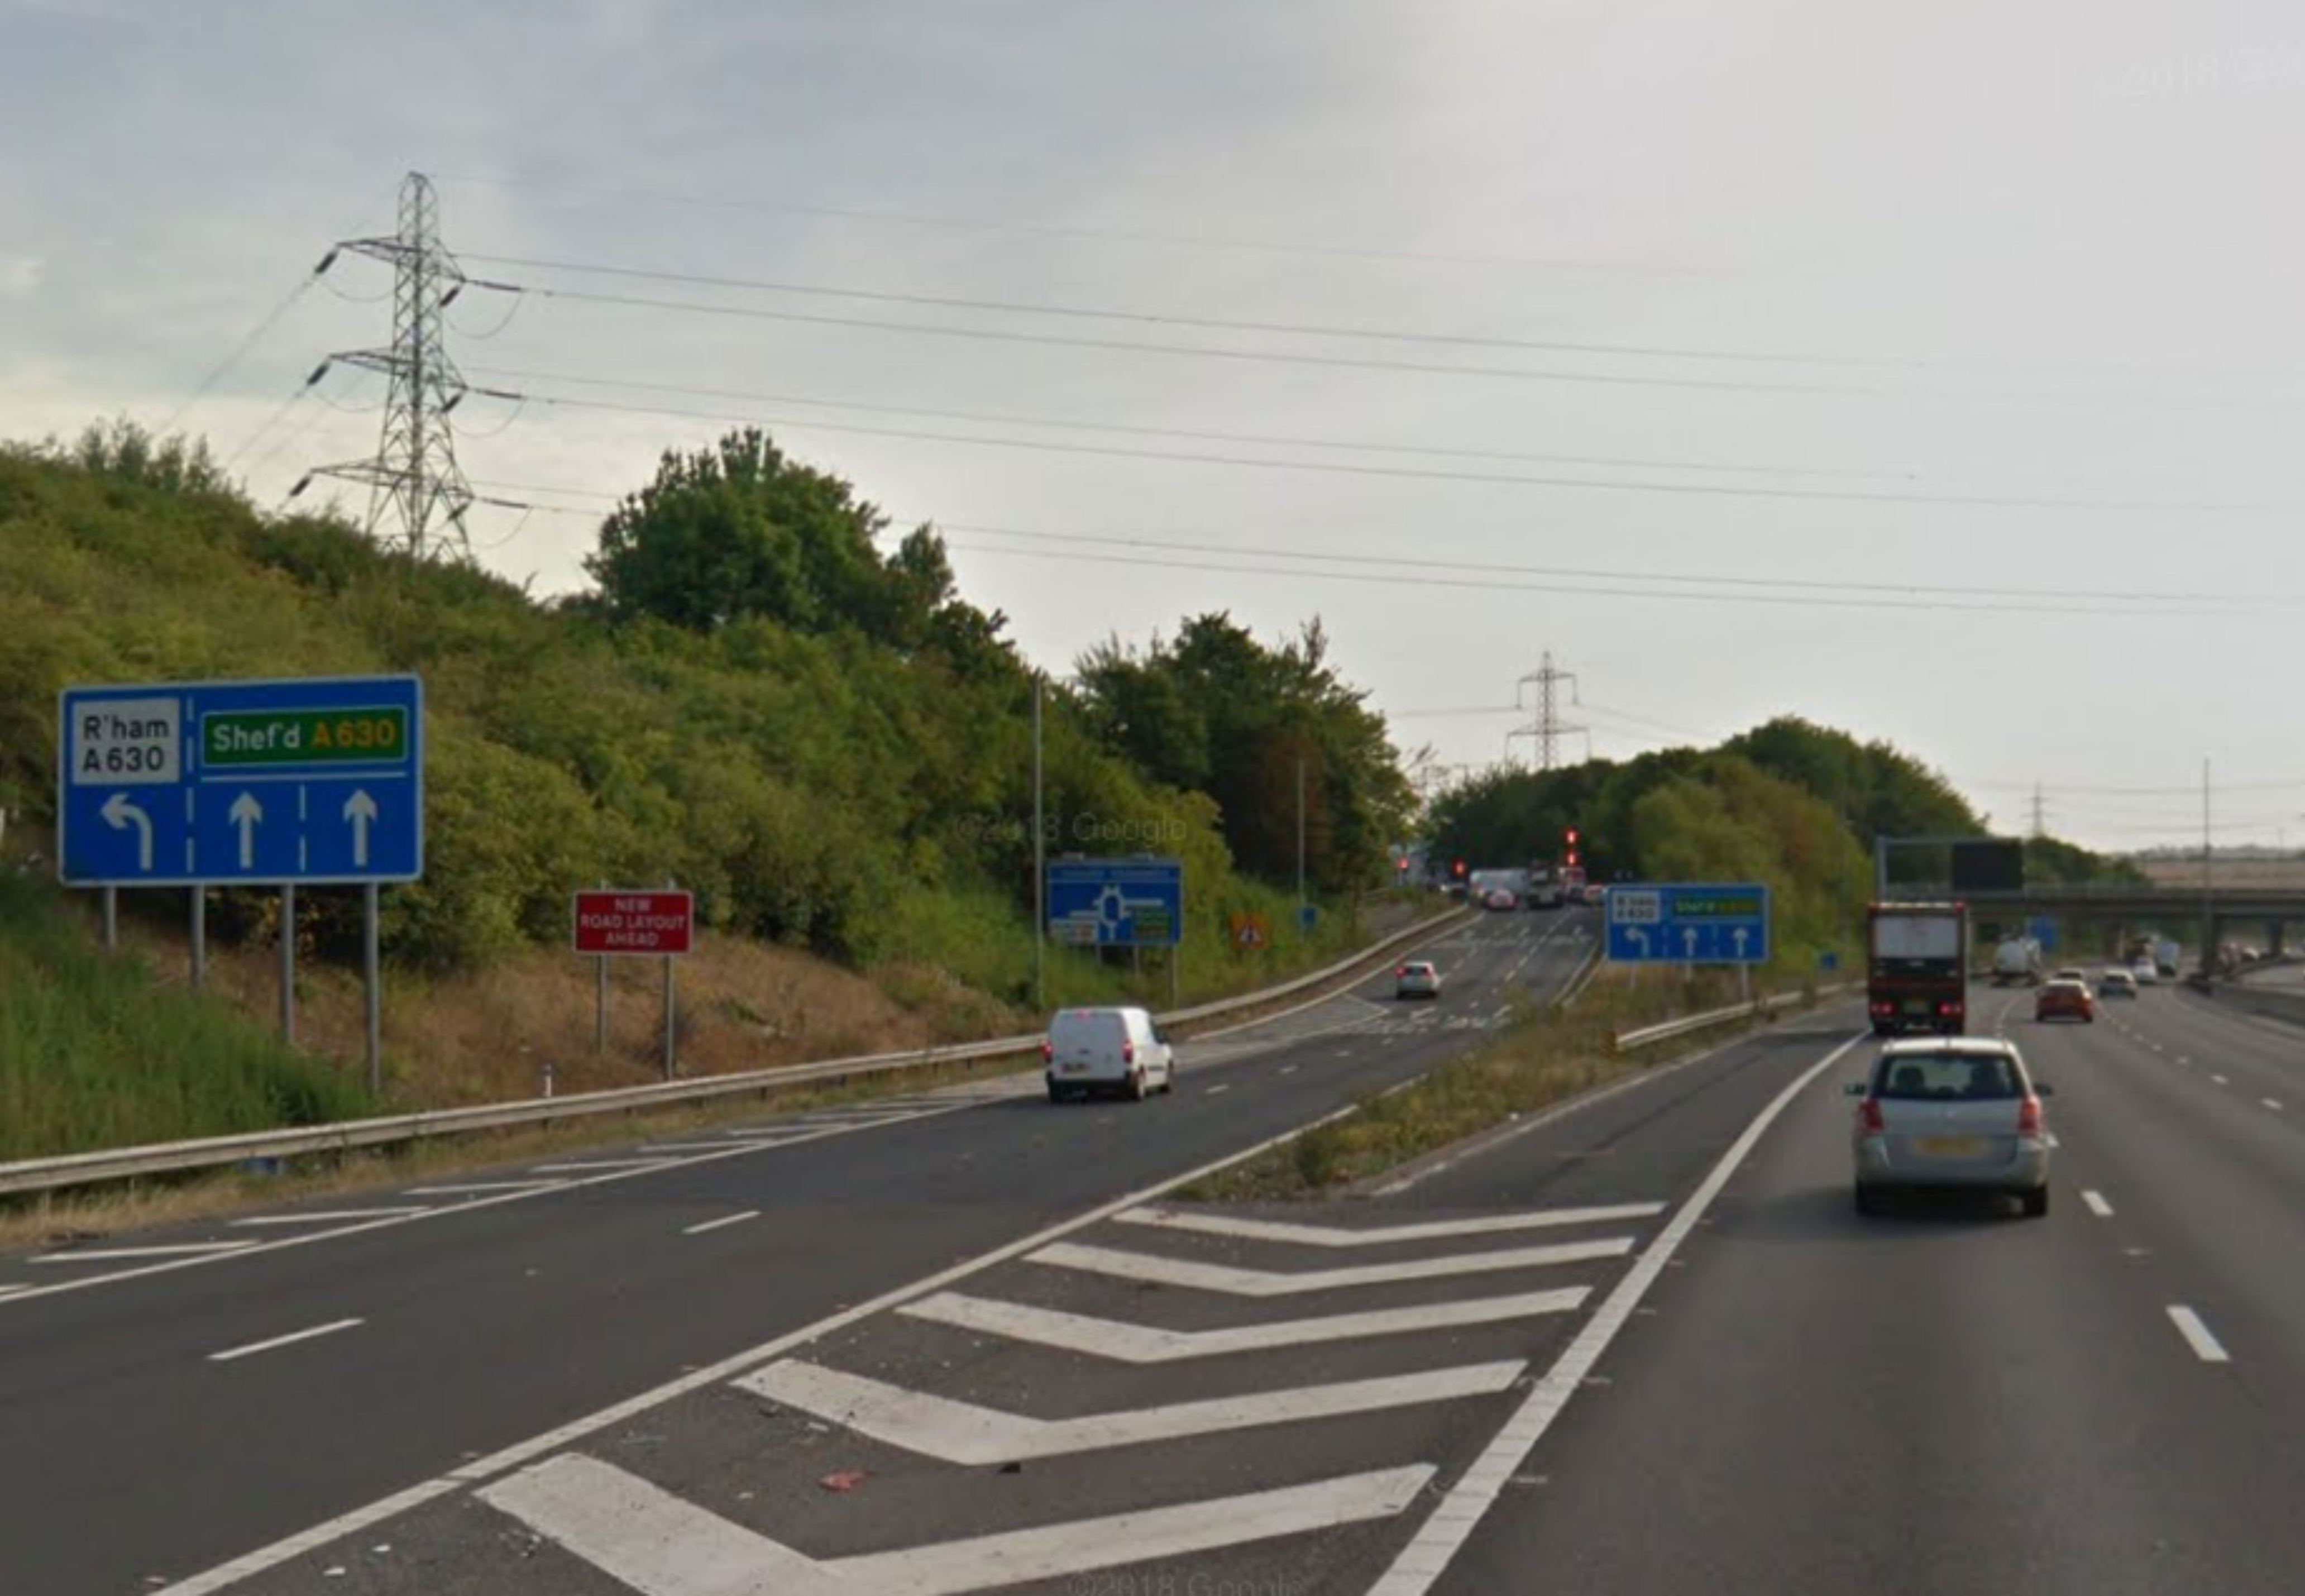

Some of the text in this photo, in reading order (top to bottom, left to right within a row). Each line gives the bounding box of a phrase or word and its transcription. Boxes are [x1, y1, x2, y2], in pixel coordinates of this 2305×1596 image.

[83, 715, 169, 740] R'ham
[213, 719, 396, 752] Shef'd A630
[83, 747, 164, 772] A630
[615, 898, 651, 912] NEW
[580, 914, 685, 931] ROAD LAYOUT
[605, 931, 659, 947] AHEAD
